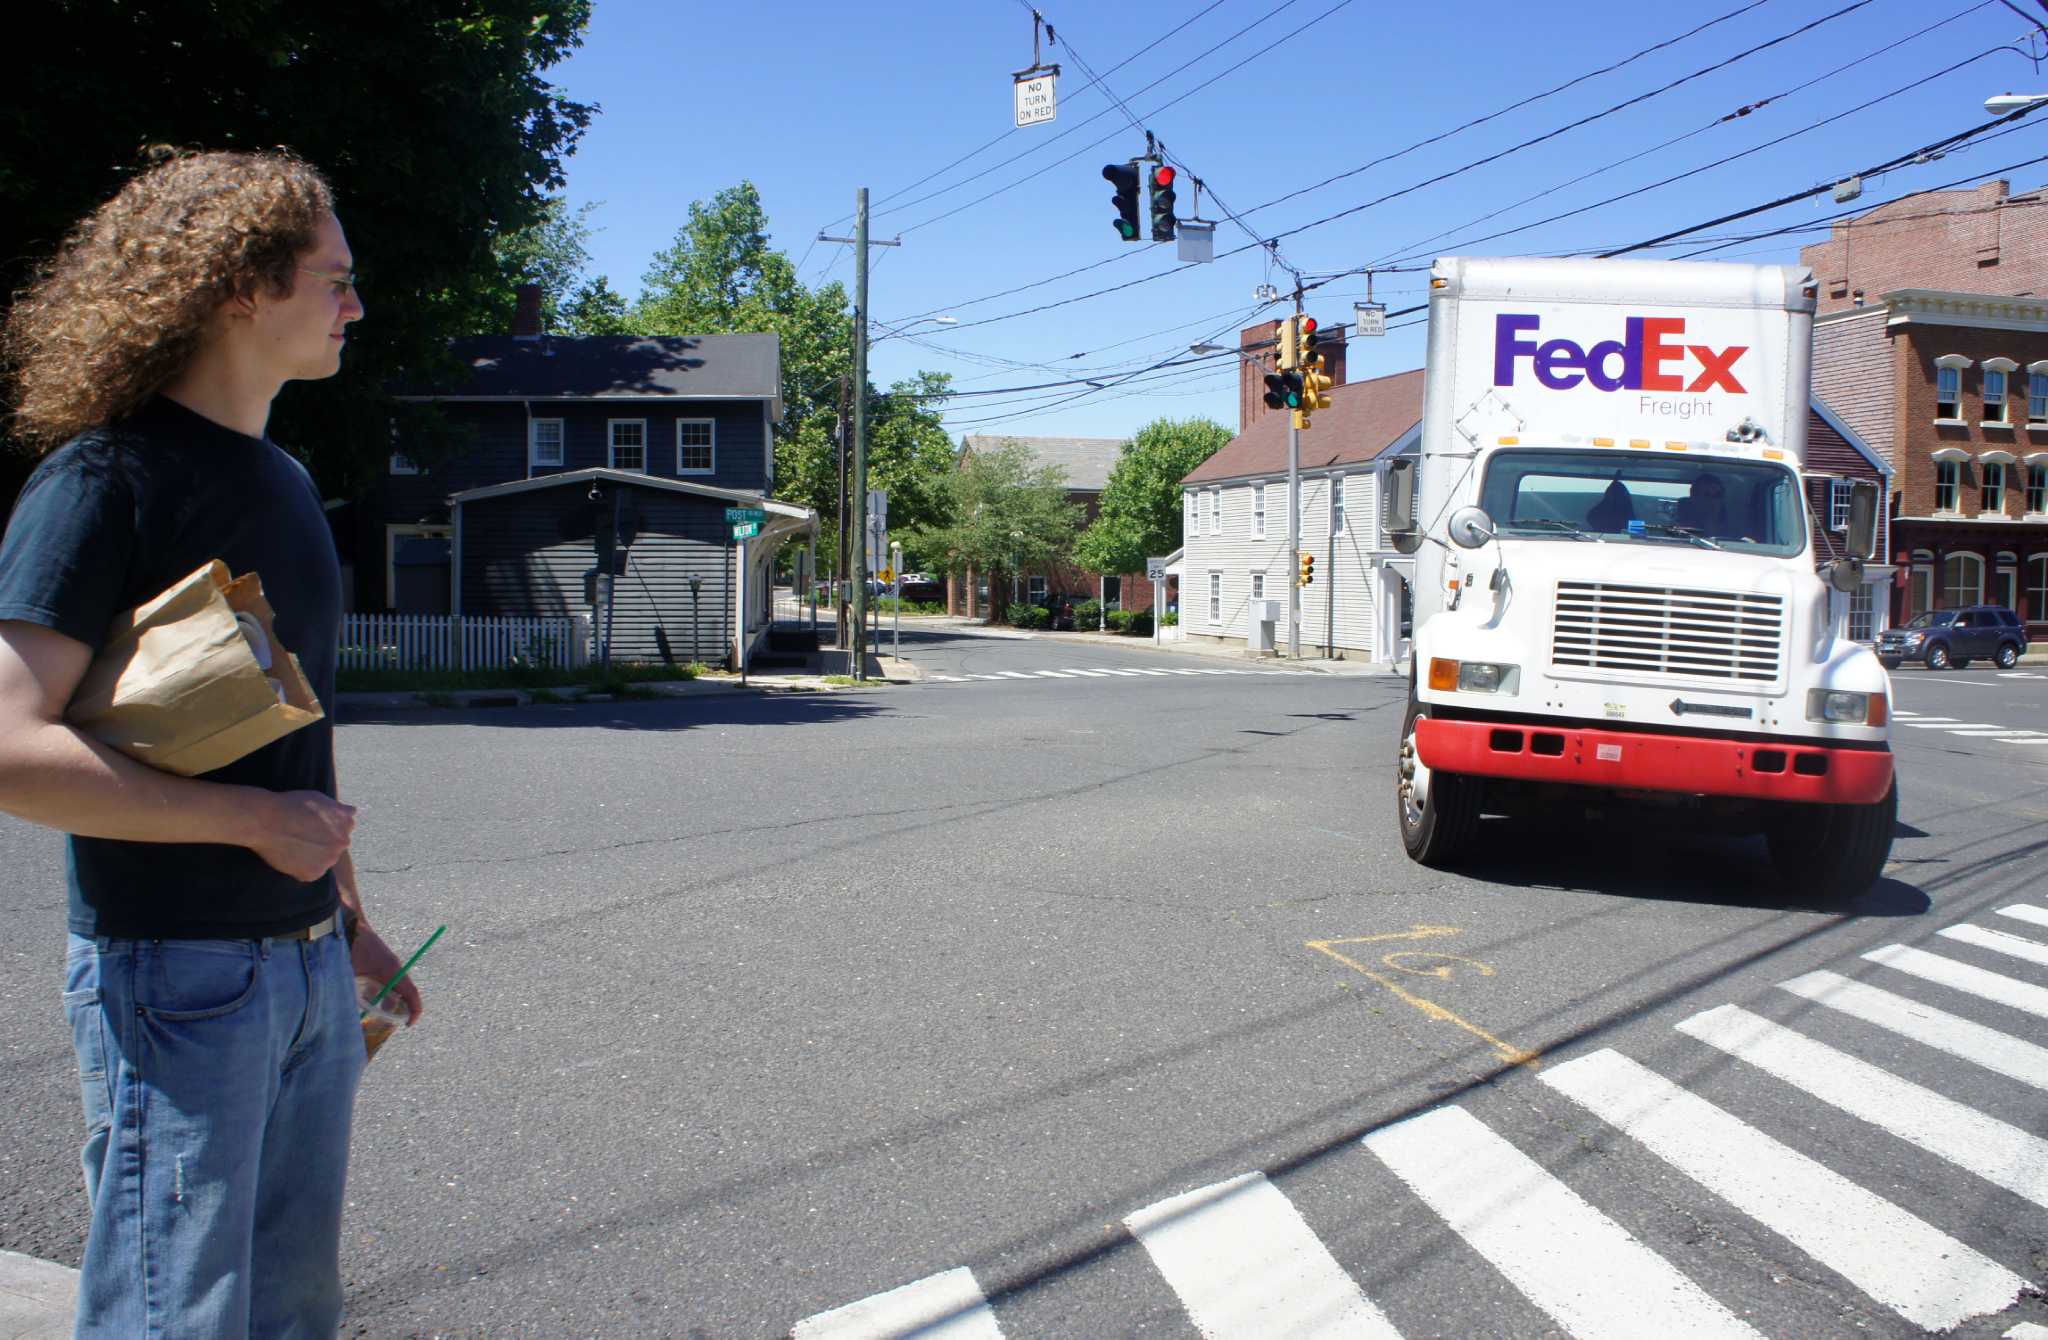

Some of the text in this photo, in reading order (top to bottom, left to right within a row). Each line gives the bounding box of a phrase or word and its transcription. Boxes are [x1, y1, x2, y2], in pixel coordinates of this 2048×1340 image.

[1028, 82, 1042, 93] NO
[1025, 95, 1047, 106] TURN
[1020, 106, 1052, 120] ON RED
[1494, 314, 1749, 393] FedEx
[1639, 396, 1713, 419] Freight
[726, 509, 746, 521] POST
[1149, 569, 1164, 578] 25
